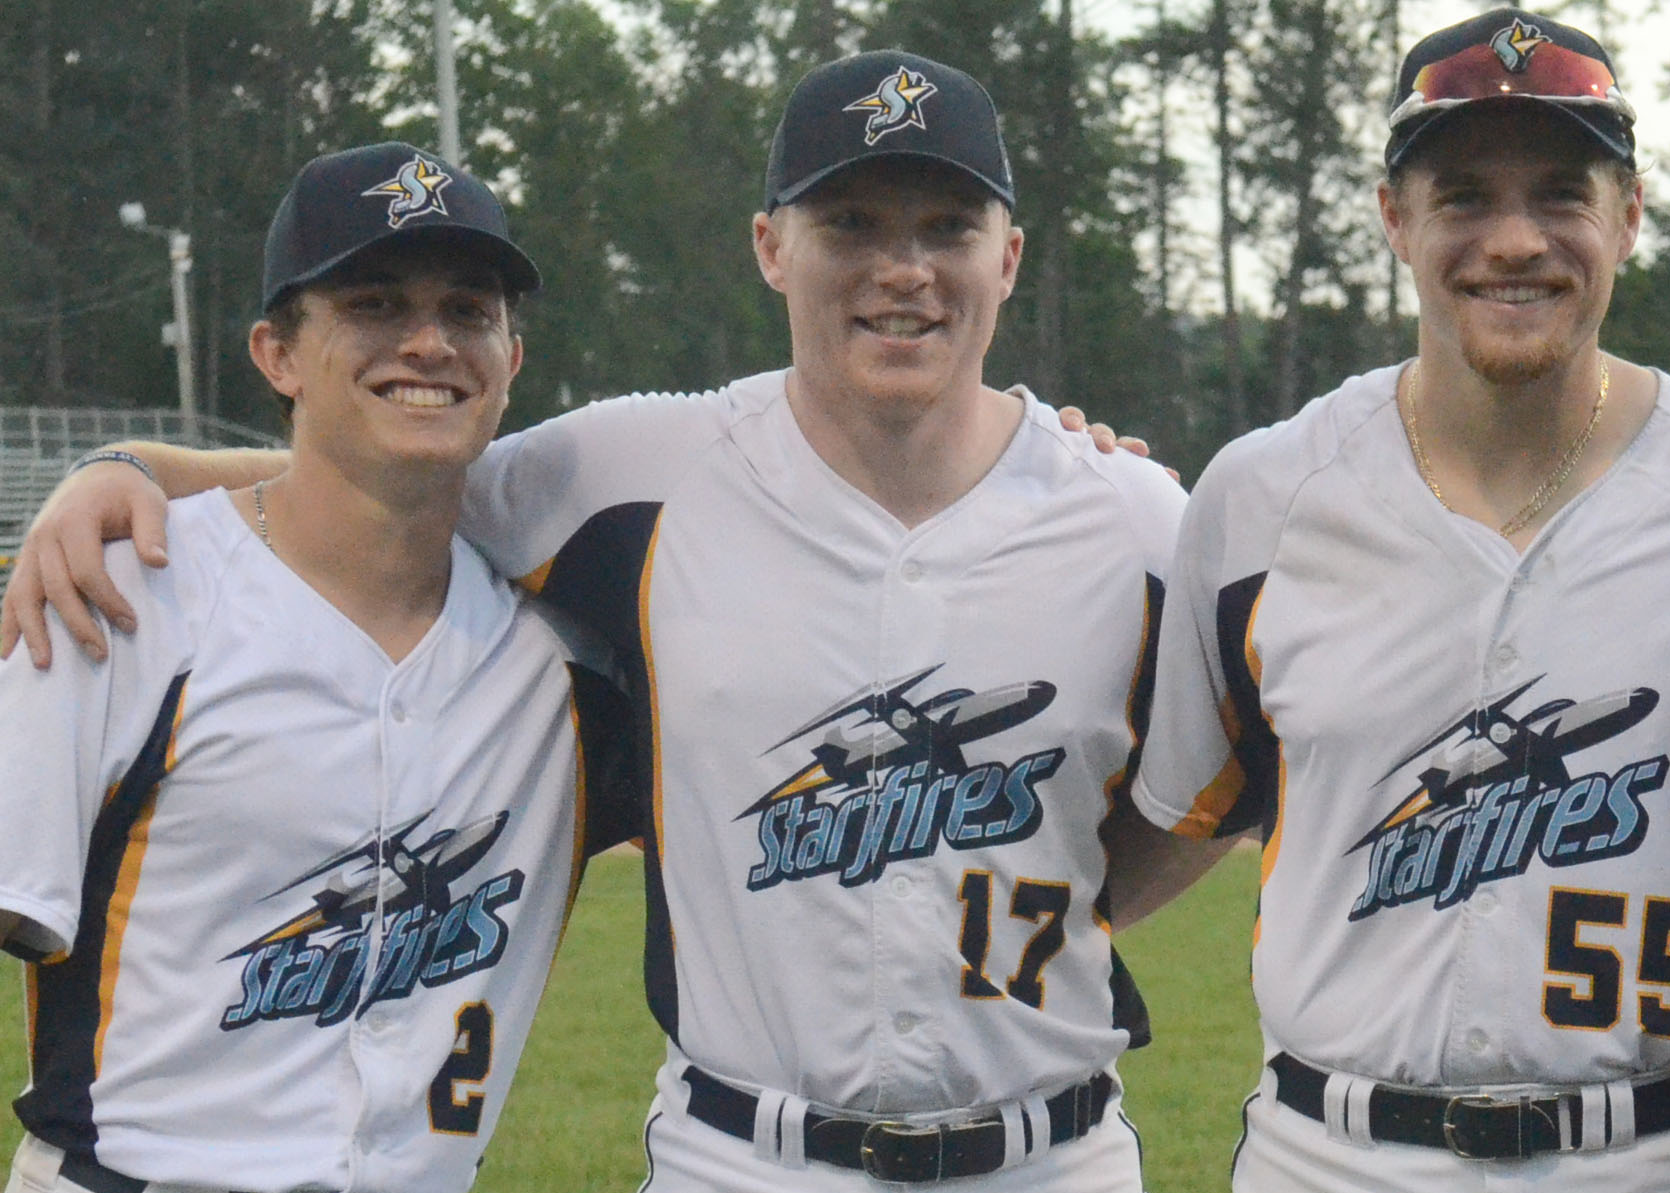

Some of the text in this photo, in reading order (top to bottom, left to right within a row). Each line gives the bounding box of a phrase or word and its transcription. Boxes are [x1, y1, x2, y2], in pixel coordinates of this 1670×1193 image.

[747, 747, 1067, 892] Starfires
[1347, 754, 1670, 922] Starfires
[220, 868, 526, 1032] Starfires
[957, 868, 1071, 1012] 17
[426, 998, 494, 1137] 2
